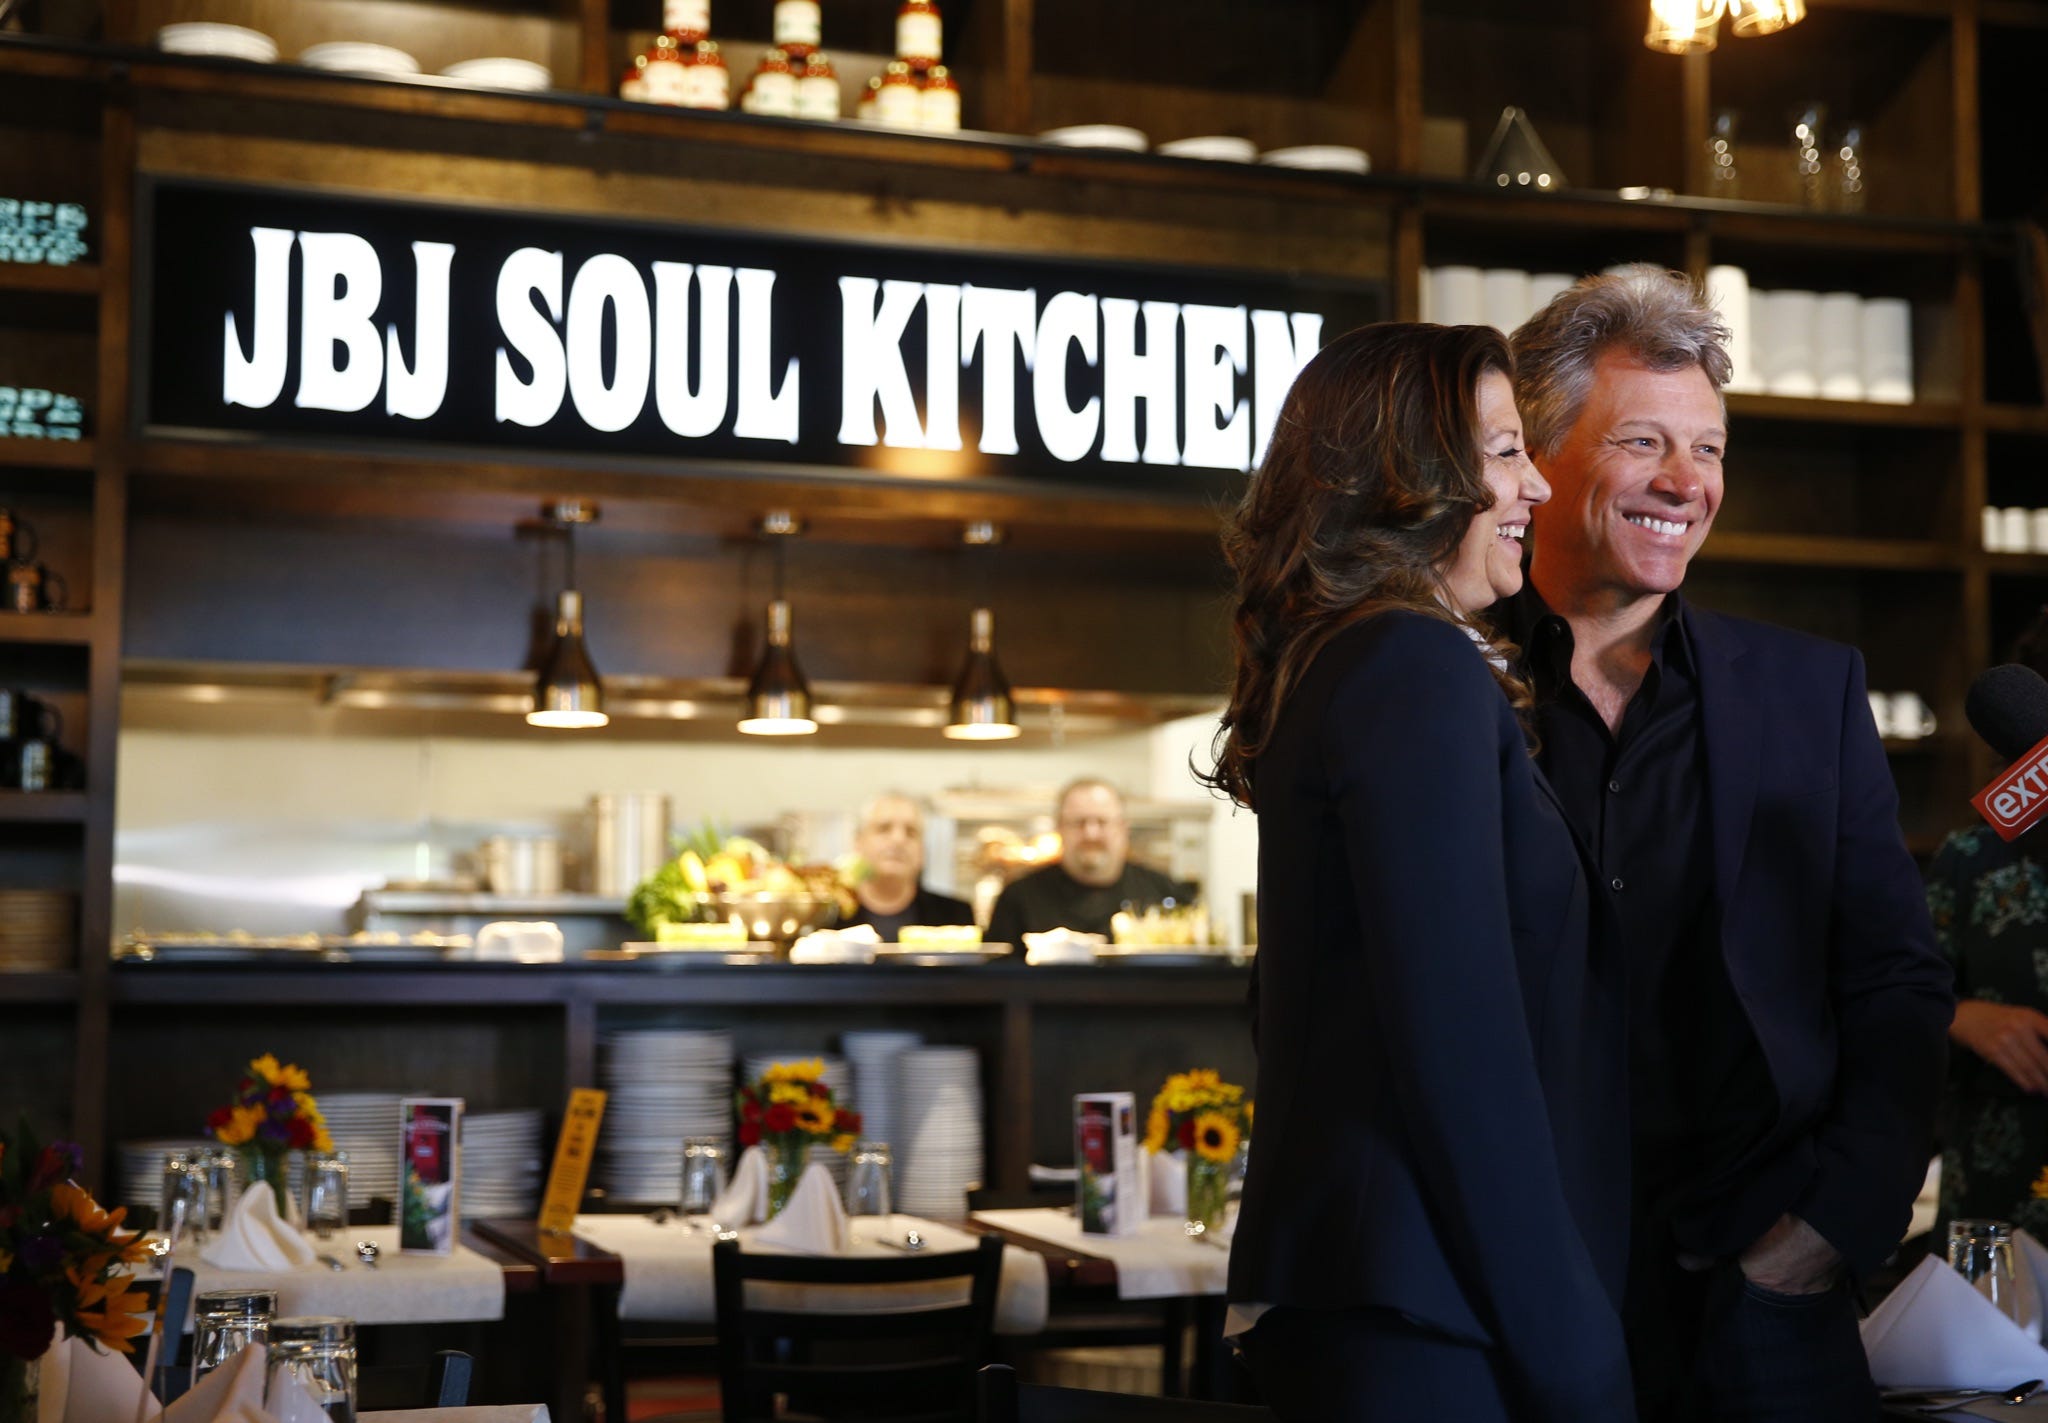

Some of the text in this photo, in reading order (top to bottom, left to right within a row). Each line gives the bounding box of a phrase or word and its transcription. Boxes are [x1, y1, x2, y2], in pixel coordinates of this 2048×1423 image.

[223, 226, 1324, 473] JBJ SOUL KITCHEN
